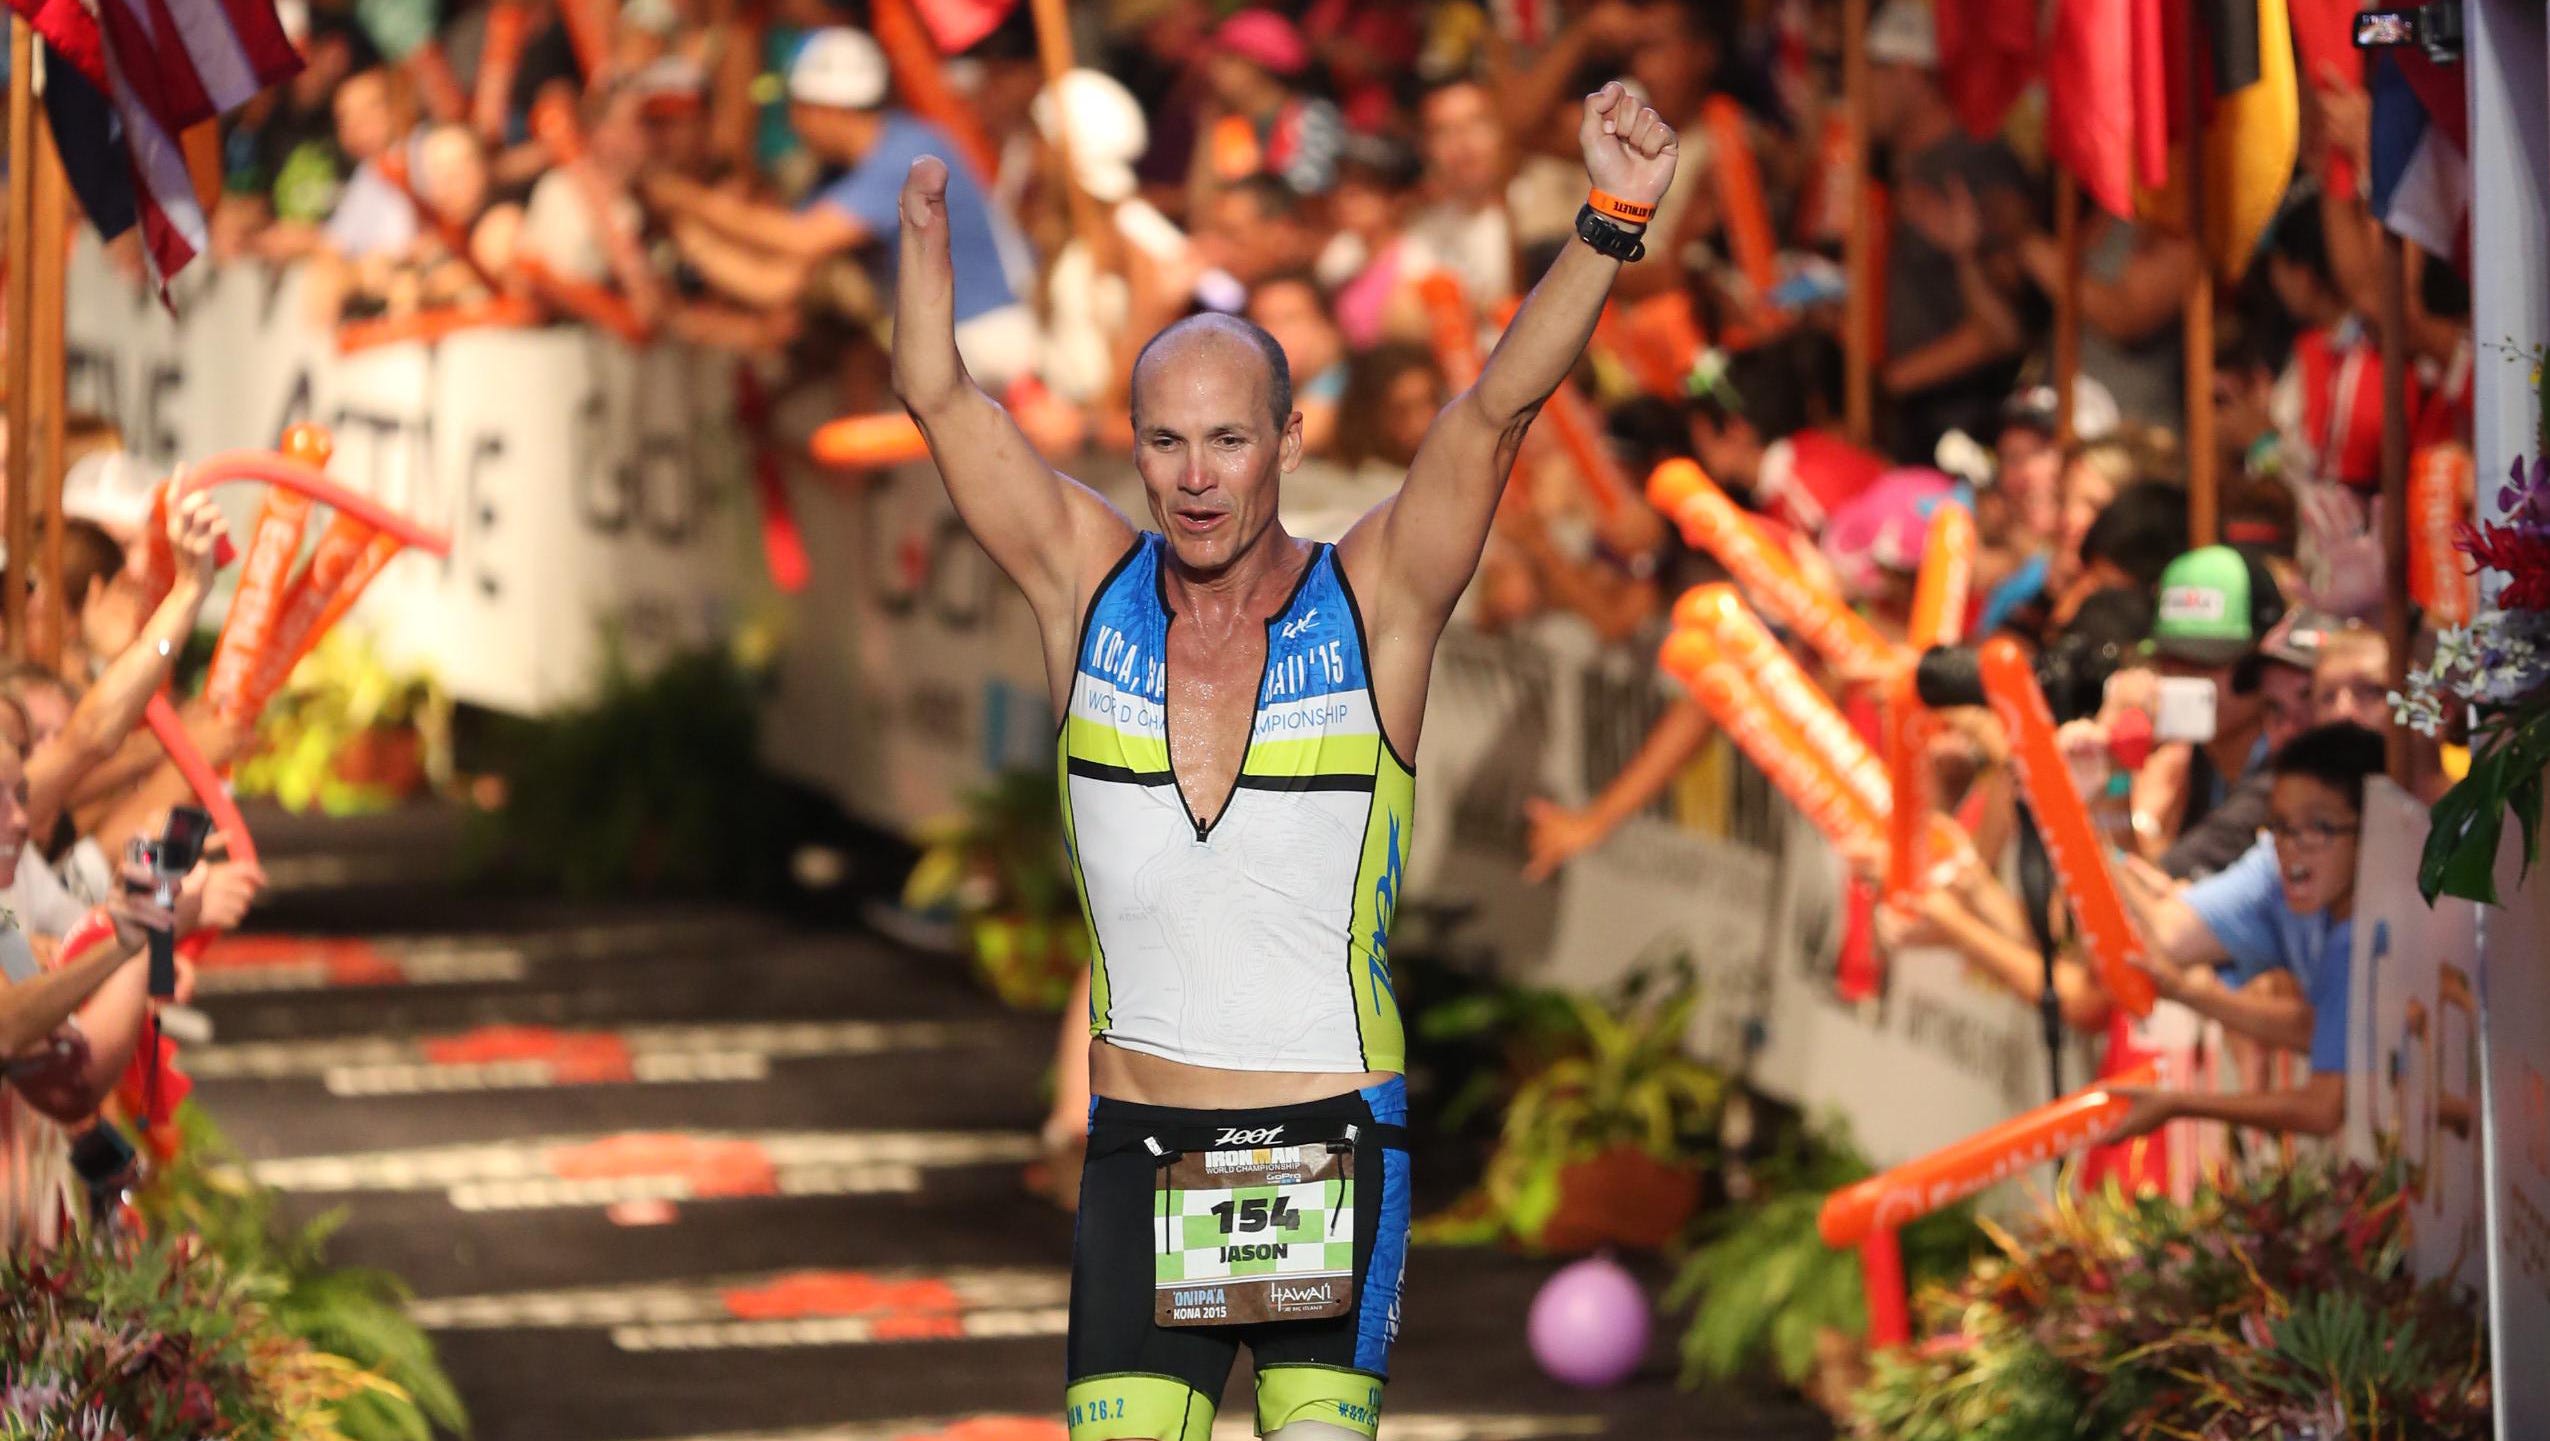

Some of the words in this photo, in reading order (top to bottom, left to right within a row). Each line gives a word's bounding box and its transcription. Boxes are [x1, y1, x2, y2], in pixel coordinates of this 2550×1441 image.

[1309, 640, 1344, 685] '15
[1205, 1146, 1300, 1168] IRONMAN
[1205, 1166, 1236, 1175] WORLD
[1236, 1162, 1301, 1174] CHAMPIONSHIP
[1210, 1196, 1300, 1234] 154
[1220, 1243, 1288, 1263] JASON
[1173, 1307, 1201, 1320] KONA
[1202, 1306, 1227, 1319] 2015
[1089, 1398, 1124, 1422] 26.2
